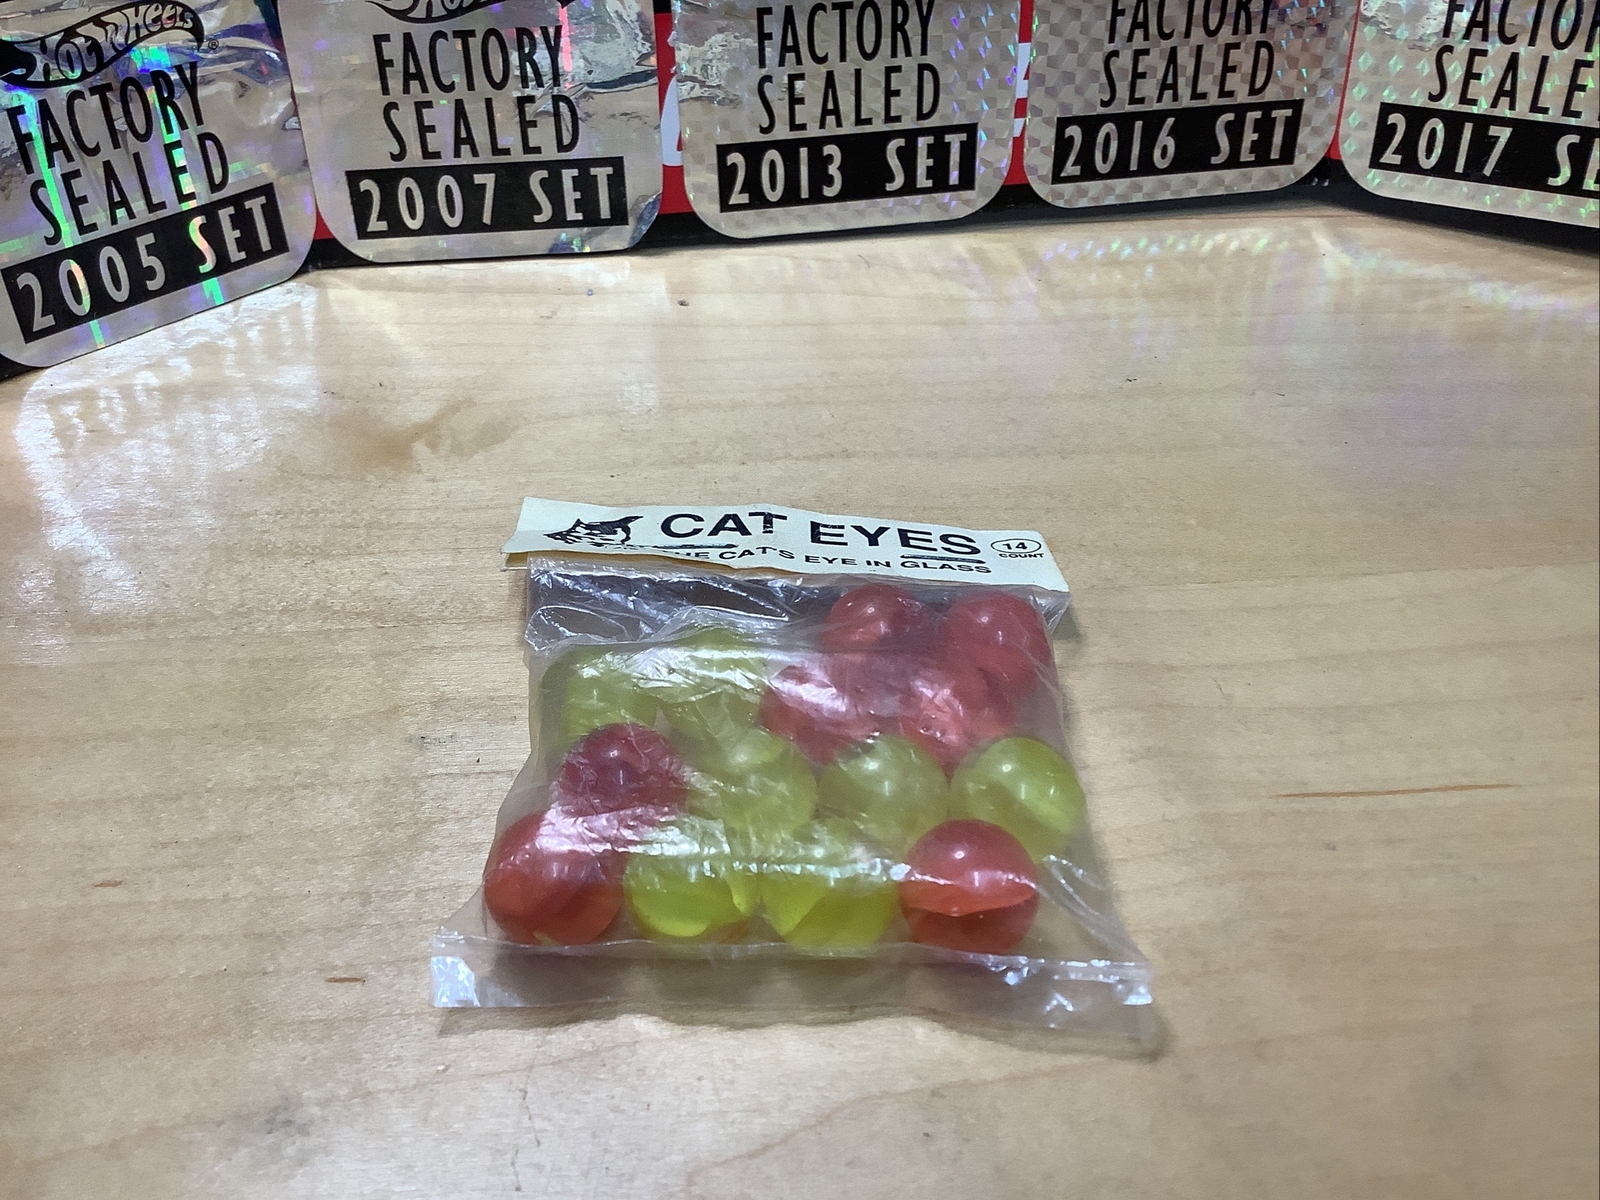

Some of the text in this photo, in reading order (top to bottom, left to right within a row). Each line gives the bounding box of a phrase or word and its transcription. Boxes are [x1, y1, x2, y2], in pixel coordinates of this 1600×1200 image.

[372, 25, 562, 96] FACTORY
[756, 0, 934, 69] FACTORY
[758, 63, 940, 135] SEALED
[1100, 40, 1275, 108] SEALED
[1428, 44, 1599, 121] SEALE
[6, 61, 205, 175] FACTORY
[382, 94, 580, 162] SEALED
[1060, 109, 1293, 177] 2016 SET
[1379, 113, 1513, 177] 2017
[30, 132, 230, 246] SEALED
[359, 167, 614, 233] 2007 SET
[726, 133, 967, 205] 2013 SET
[16, 197, 273, 332] 2005 SET
[661, 511, 982, 555] CAT EYES
[804, 554, 858, 566] EYE
[866, 559, 891, 568] IN
[900, 560, 992, 574] GLASS
